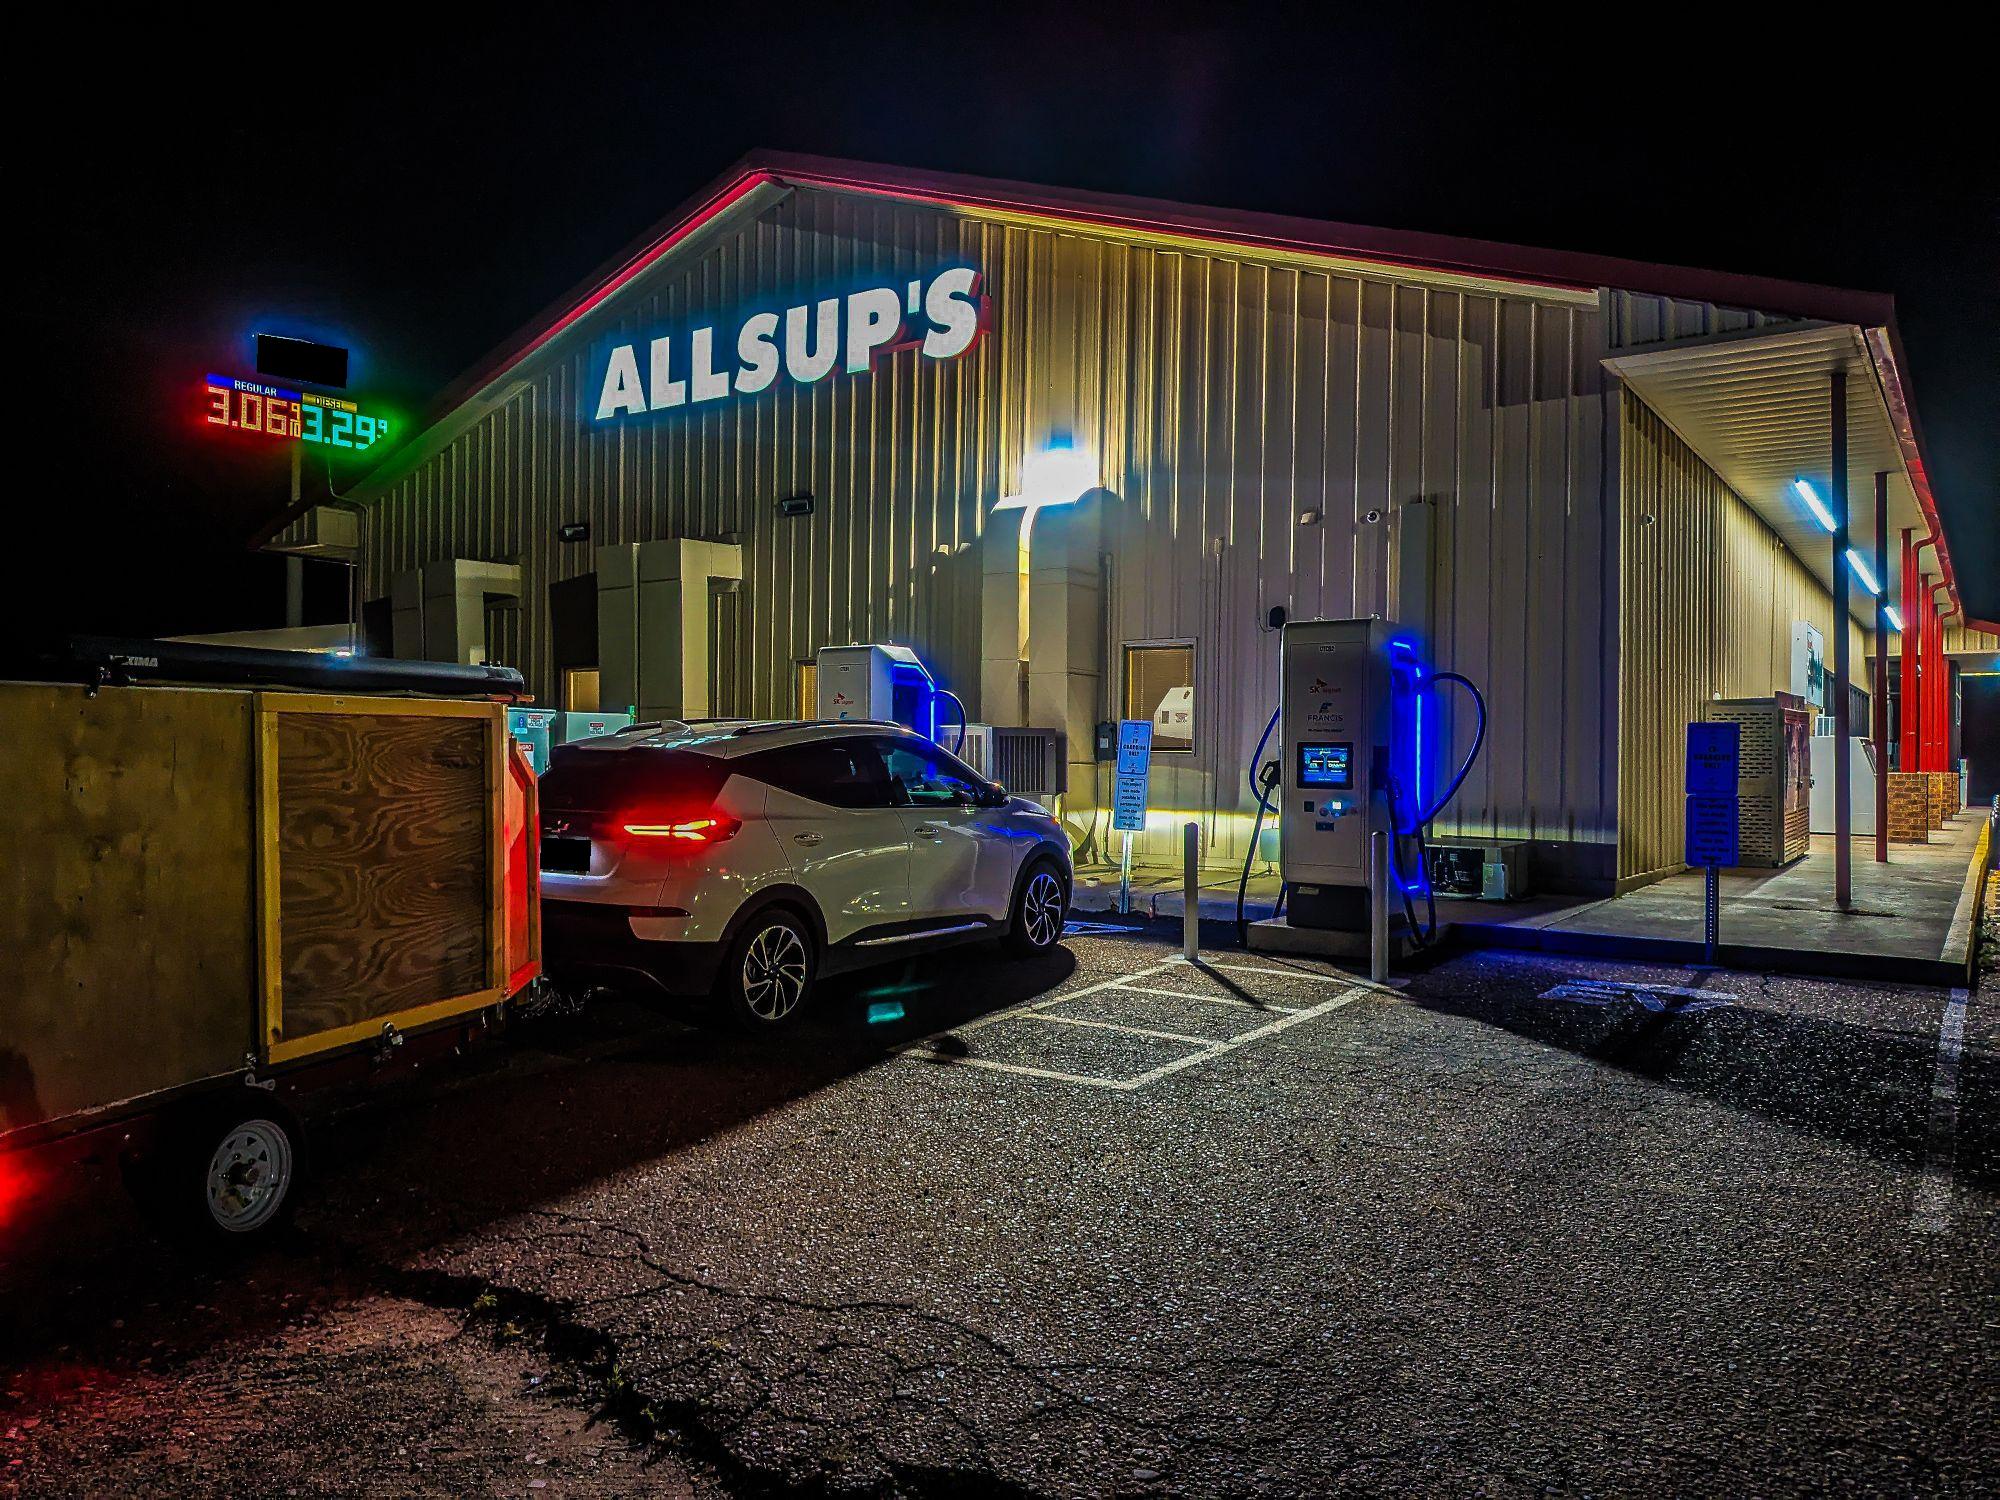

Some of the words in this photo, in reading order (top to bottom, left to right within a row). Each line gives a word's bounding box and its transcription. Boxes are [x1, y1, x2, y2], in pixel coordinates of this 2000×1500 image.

[595, 268, 979, 420] ALLSUP'S
[234, 379, 277, 397] REGULAR
[315, 396, 345, 411] DIESEL
[207, 386, 287, 436] 3.06
[302, 404, 376, 450] 3.29
[1307, 714, 1344, 722] FRANCIS
